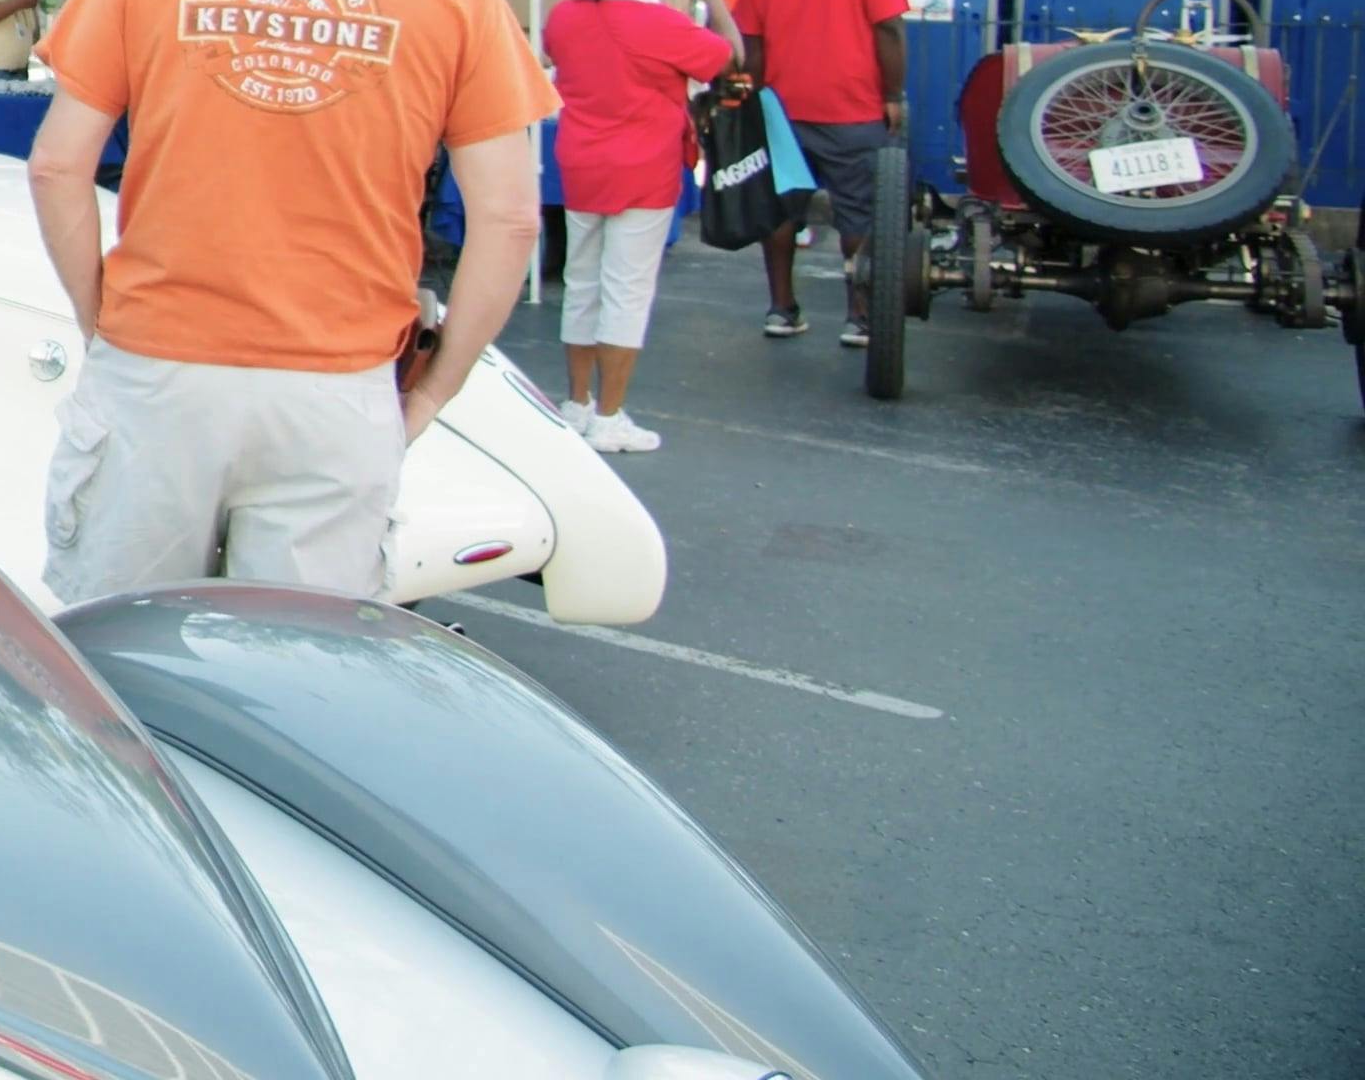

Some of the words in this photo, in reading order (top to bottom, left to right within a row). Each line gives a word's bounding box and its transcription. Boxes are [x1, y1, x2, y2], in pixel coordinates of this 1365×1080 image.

[197, 7, 381, 51] KEYSTONE
[231, 55, 333, 83] COLORADO
[240, 77, 273, 101] EST.
[277, 86, 318, 103] 1970
[1111, 153, 1169, 176] 41118
